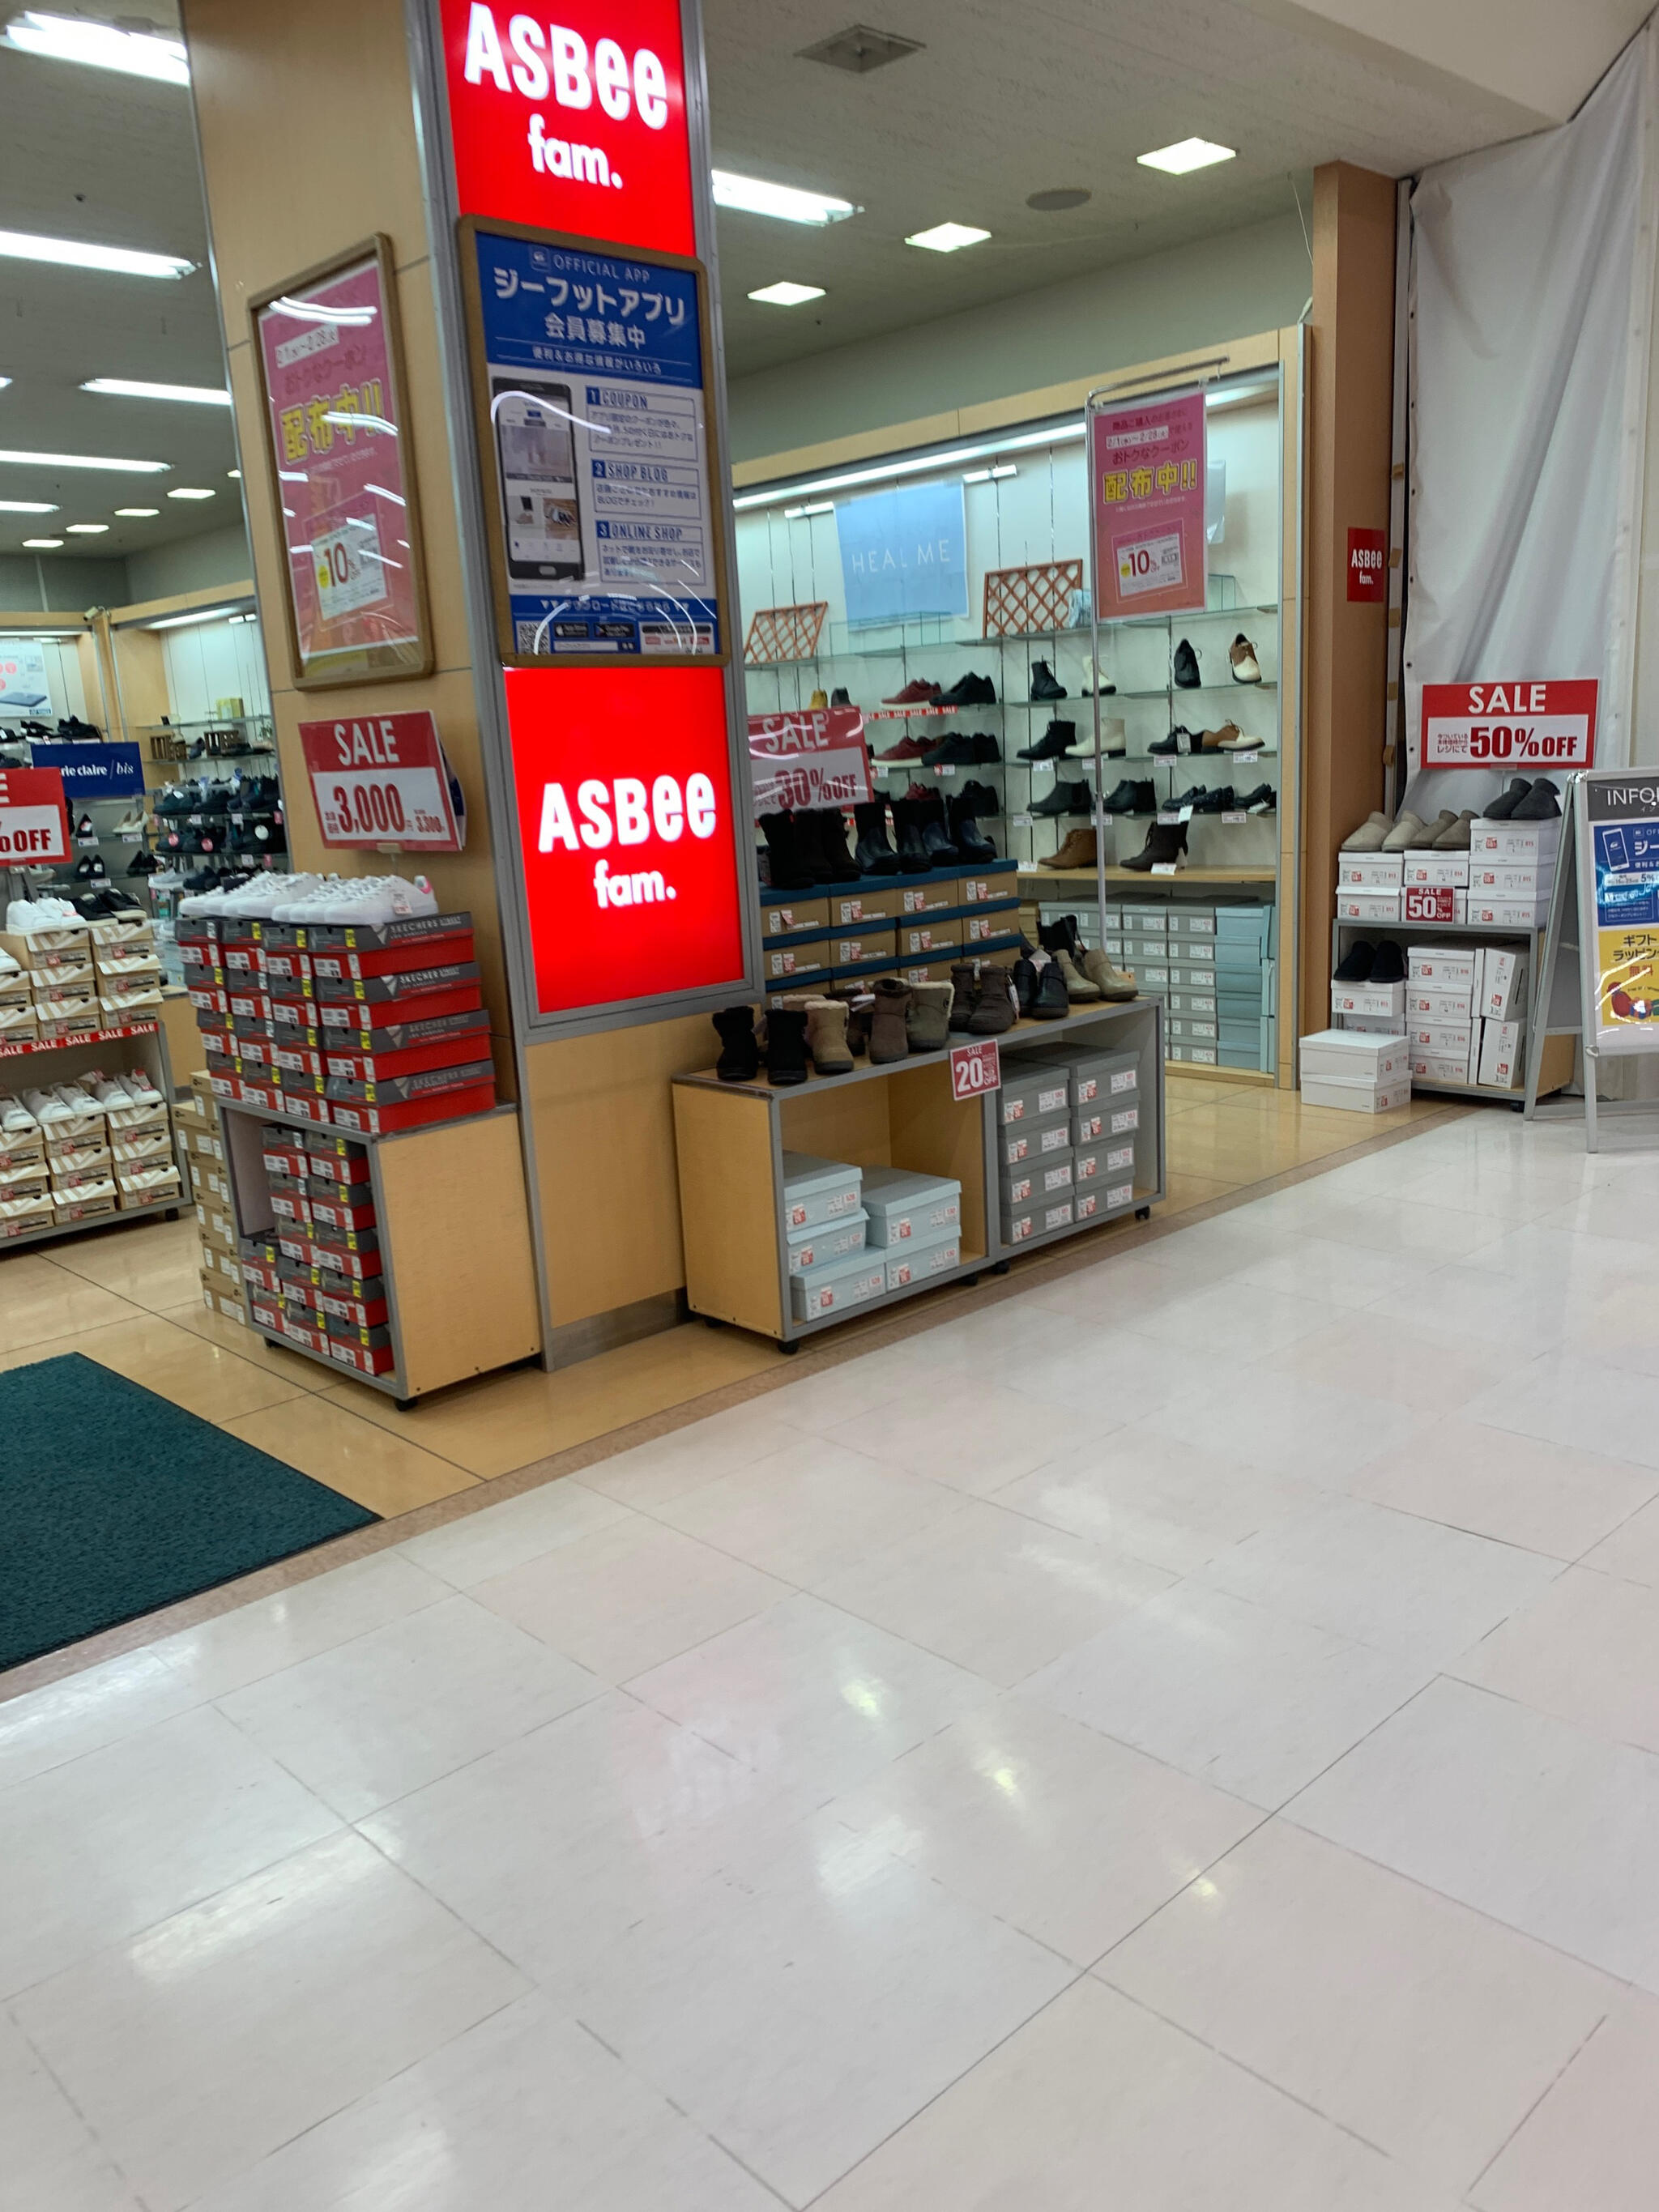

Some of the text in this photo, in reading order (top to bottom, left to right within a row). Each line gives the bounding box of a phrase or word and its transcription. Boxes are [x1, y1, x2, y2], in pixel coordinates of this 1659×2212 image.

[464, 2, 667, 130] ASBee
[527, 113, 623, 190] fam.
[553, 254, 650, 283] OFFICIAL APP
[493, 266, 685, 326] ジーフットアプリ
[544, 312, 646, 349] 会員募集中
[602, 390, 647, 409] COUPON
[608, 462, 638, 479] SHOP
[640, 466, 668, 483] BLOG
[1103, 458, 1197, 505] 配布中!!
[612, 522, 650, 539] ONLINE
[654, 526, 683, 541] SHOP
[324, 542, 348, 587] 10
[851, 539, 951, 574] HEAL ME
[1128, 549, 1150, 578] 10
[1351, 548, 1383, 569] ASBee
[1467, 684, 1546, 714] SALE
[334, 719, 400, 766] SALE
[761, 712, 830, 753] SALE
[77, 764, 108, 777] claire
[117, 762, 134, 776] bis
[333, 783, 406, 834] 3,000
[1408, 895, 1437, 918] 50
[1613, 948, 1659, 961] ラッピン
[1623, 934, 1657, 947] ギフト
[31, 1038, 58, 1053] SALE
[65, 1033, 92, 1046] SALE
[98, 1028, 124, 1041] SALE
[130, 1023, 156, 1036] SALE
[956, 1057, 983, 1093] 20
